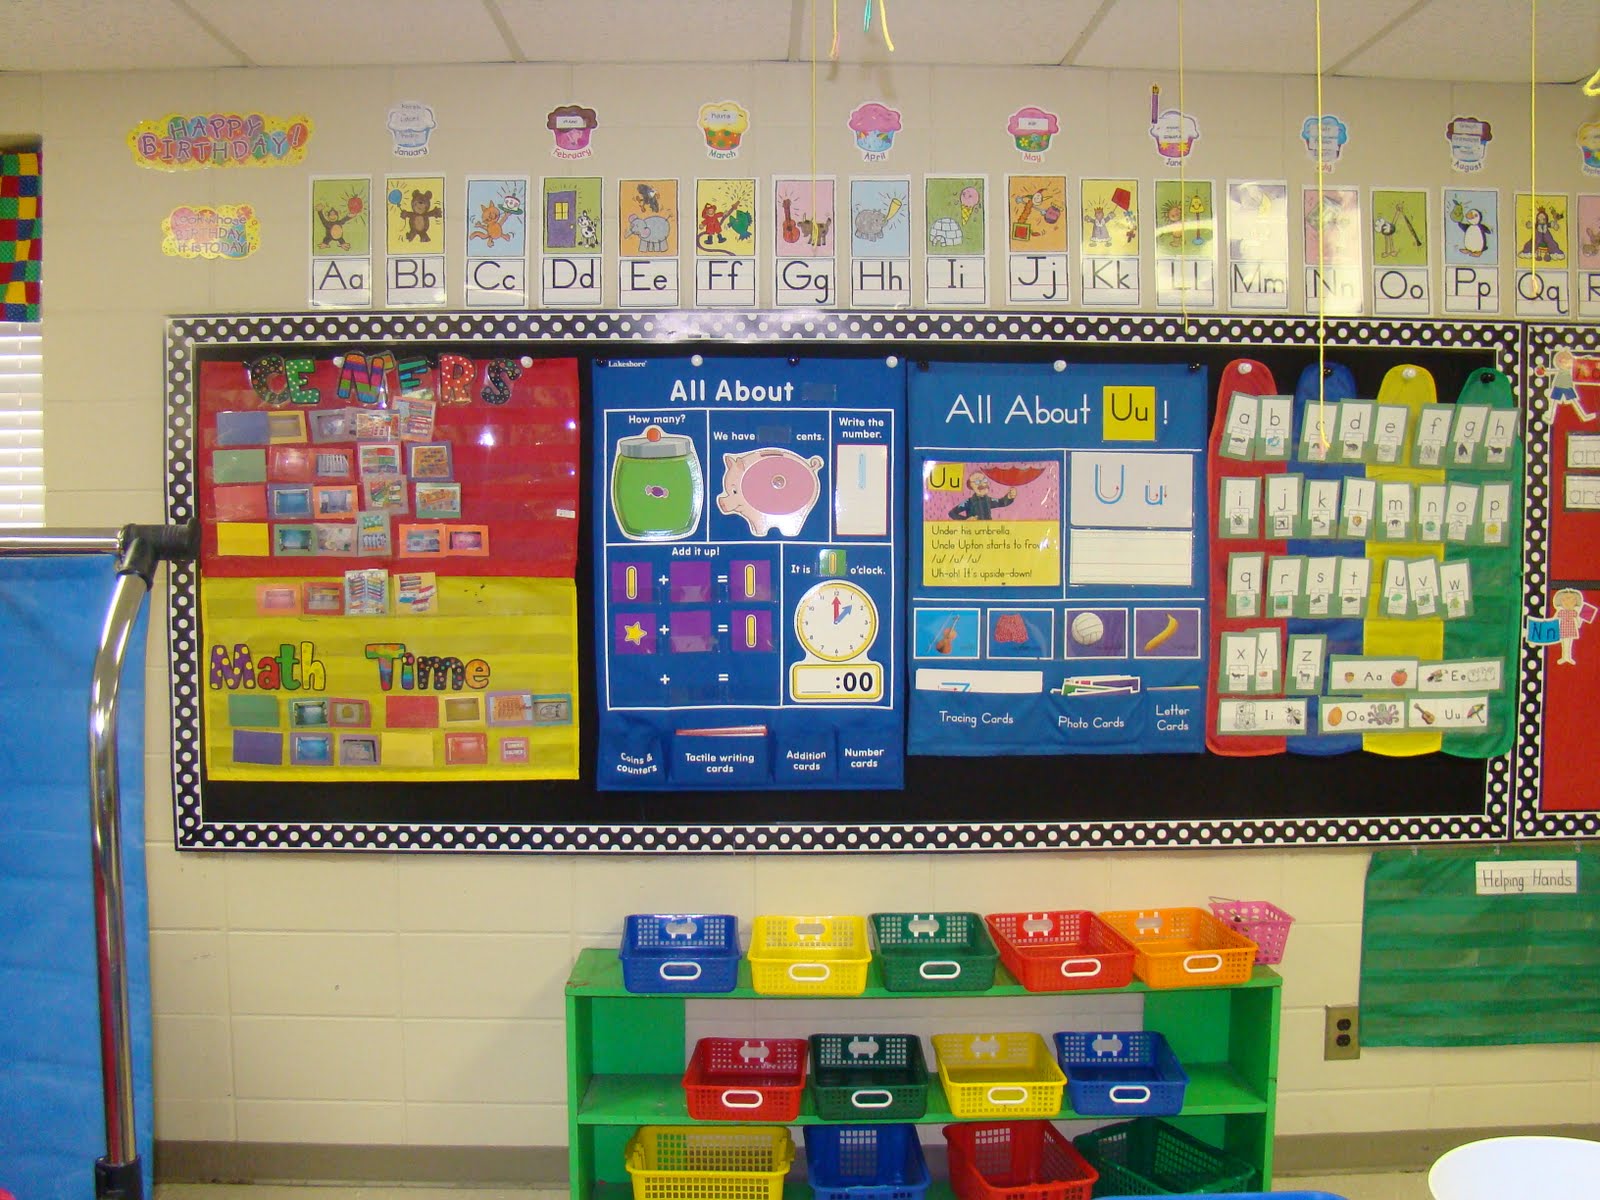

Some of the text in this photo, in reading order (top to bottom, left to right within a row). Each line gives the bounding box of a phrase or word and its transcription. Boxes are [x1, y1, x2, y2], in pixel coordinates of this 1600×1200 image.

[169, 118, 262, 140] HAPPY
[394, 147, 428, 156] January
[553, 148, 592, 159] February
[709, 149, 736, 159] March
[864, 152, 886, 161] April
[1023, 152, 1041, 163] May
[1454, 160, 1482, 173] August
[206, 214, 246, 226] whose
[176, 228, 244, 241] BIRTHDAY
[201, 242, 251, 253] TODAY!
[319, 261, 363, 290] Aa
[395, 261, 436, 289] Bb
[474, 261, 515, 290] Cc
[552, 259, 595, 289] Dd
[631, 261, 667, 290] Ee
[708, 261, 742, 290] Ff
[860, 261, 902, 290] Hh
[947, 259, 964, 289] Ii
[1018, 256, 1057, 299] Jj
[1092, 260, 1130, 289] Kk
[1171, 261, 1198, 290] Ll
[1234, 264, 1284, 293] Mm
[782, 261, 829, 303] Gg
[1380, 271, 1424, 299] Oo
[1455, 268, 1491, 310] Pp
[1518, 272, 1568, 314] Qq
[608, 360, 646, 368] Lakeshore
[670, 379, 794, 402] All About
[946, 394, 991, 424] All
[1004, 394, 1091, 424] About
[1111, 393, 1148, 421] Uu
[628, 414, 686, 426] How many?
[838, 417, 884, 427] Write the
[1239, 413, 1250, 424] a
[1270, 407, 1281, 426] b
[1350, 411, 1362, 430] d
[1384, 422, 1396, 433] e
[1431, 417, 1442, 434] f
[1463, 421, 1476, 438] g
[1495, 418, 1505, 436] h
[713, 431, 824, 441] We have cents.
[842, 429, 882, 440] number.
[929, 467, 960, 488] Uu
[1094, 464, 1164, 505] U u
[1278, 488, 1287, 510] j
[1318, 489, 1326, 508] k
[1388, 500, 1403, 511] m
[1428, 501, 1437, 512] n
[1456, 501, 1467, 512] o
[1489, 500, 1500, 519] p
[931, 525, 1010, 535] Under his umbrella
[672, 546, 720, 558] Add it up!
[931, 540, 955, 550] Uncle
[958, 539, 984, 553] Upton
[987, 540, 1011, 550] starts
[1014, 539, 1022, 550] to
[791, 565, 801, 574] It
[803, 564, 811, 574] is
[850, 564, 886, 575] o'clock.
[931, 568, 1033, 582] Uh-oh! It's upside-down!
[1241, 572, 1461, 591] q r s t u v w
[1531, 622, 1556, 640] Nn
[1237, 648, 1312, 664] x y z
[209, 641, 490, 691] Math Time
[1364, 671, 1383, 681] Aa
[1451, 670, 1466, 681] Ee
[1155, 704, 1190, 717] Letter
[1265, 711, 1274, 721] Ii
[1346, 710, 1365, 722] Oo
[1445, 709, 1461, 721] Uu
[939, 711, 1014, 728] Tracing Cards
[1058, 716, 1125, 729] Photo Cards
[1156, 720, 1189, 731] Cards
[620, 752, 653, 765] Coins &
[685, 753, 755, 765] Tactile writing
[786, 750, 826, 760] Addition
[844, 748, 885, 758] Number
[616, 764, 657, 775] counters
[706, 764, 734, 773] cards
[793, 761, 820, 771] cards
[851, 758, 877, 768] cards
[1482, 869, 1572, 892] Helping Hands
